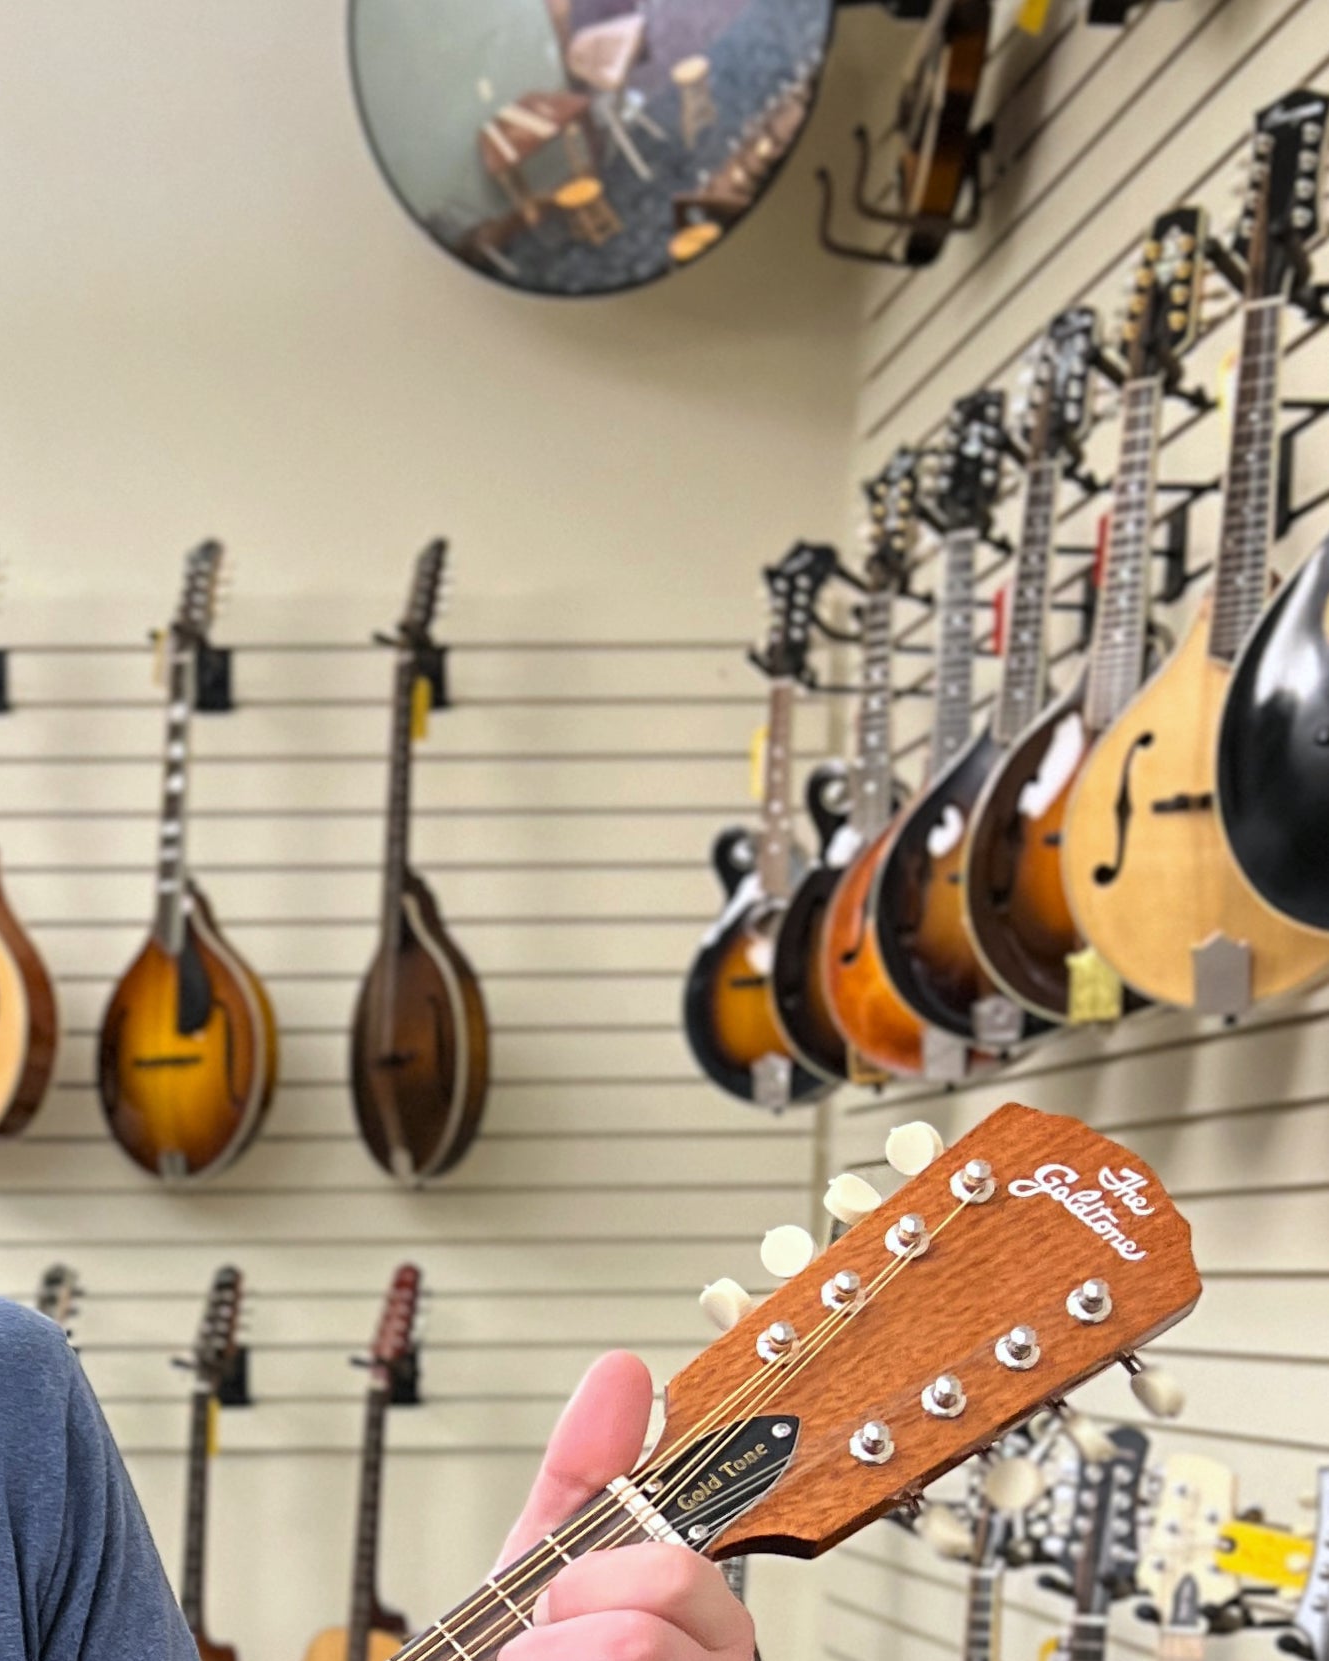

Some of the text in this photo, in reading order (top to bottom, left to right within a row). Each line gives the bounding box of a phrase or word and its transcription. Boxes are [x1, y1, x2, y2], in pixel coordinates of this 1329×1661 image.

[1008, 1163, 1147, 1261] Goldtone
[1098, 1166, 1155, 1216] The
[677, 1443, 768, 1511] Gold Tone
